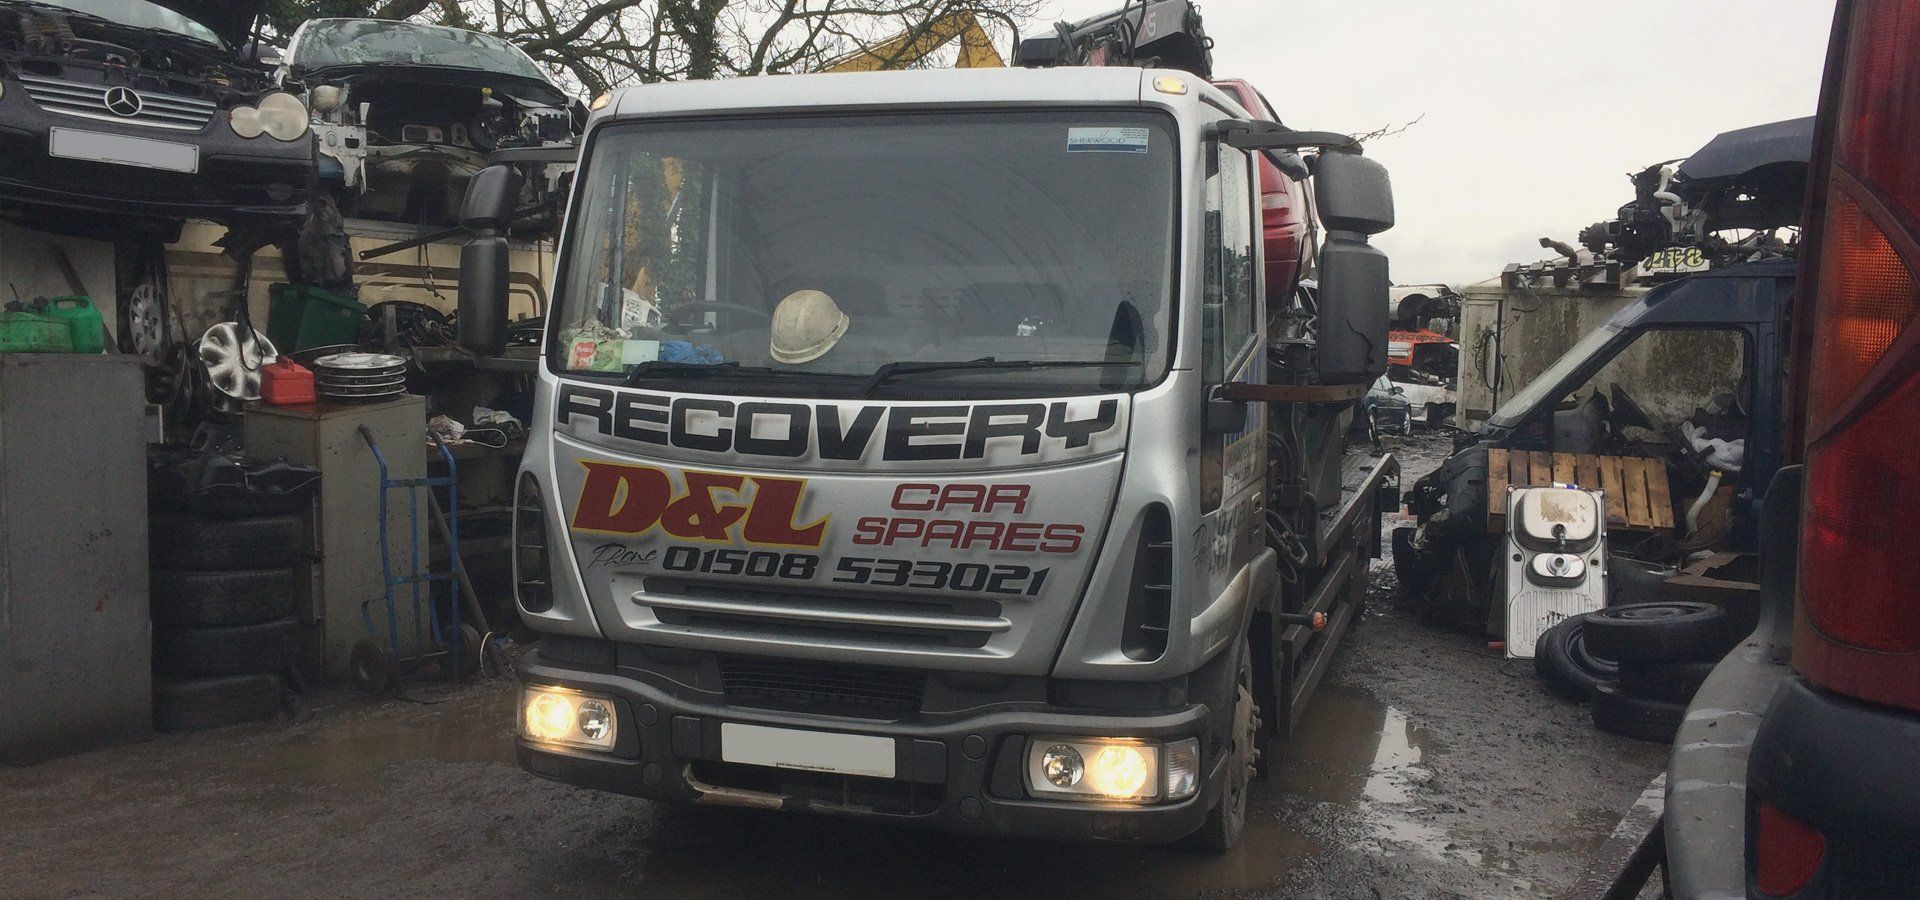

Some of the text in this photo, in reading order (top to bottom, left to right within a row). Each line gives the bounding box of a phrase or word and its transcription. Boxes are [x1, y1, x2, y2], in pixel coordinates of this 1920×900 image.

[557, 384, 1118, 461] RECOVERY
[571, 459, 832, 549] D&L
[890, 483, 1031, 514] CAR
[852, 516, 1085, 554] SPARES
[587, 542, 1051, 596] Phone 01508 533021
